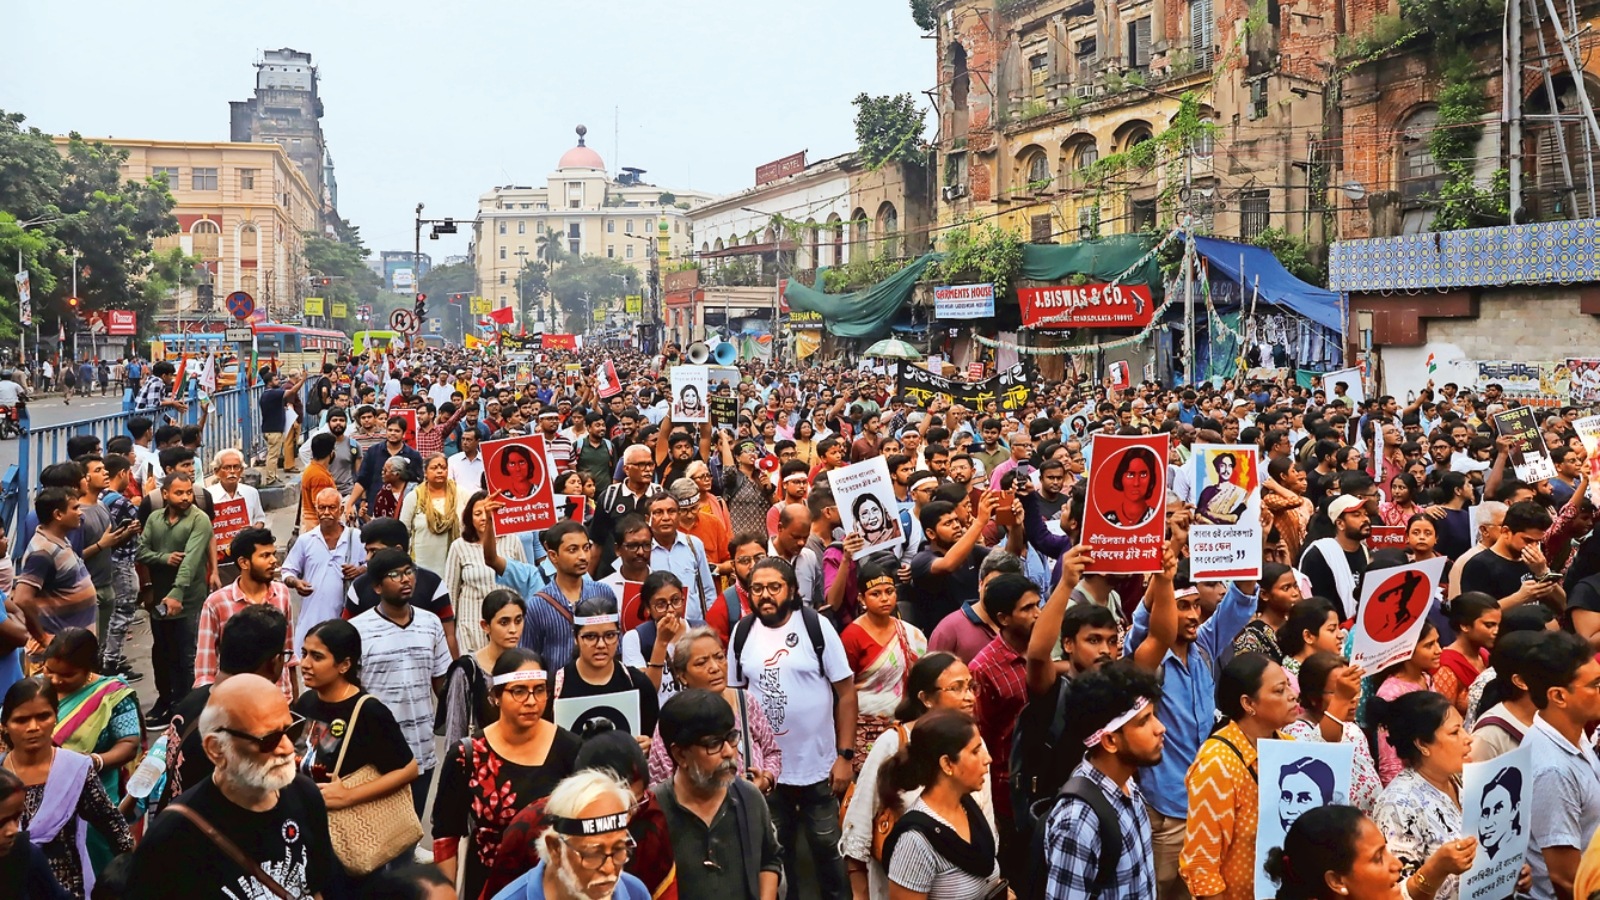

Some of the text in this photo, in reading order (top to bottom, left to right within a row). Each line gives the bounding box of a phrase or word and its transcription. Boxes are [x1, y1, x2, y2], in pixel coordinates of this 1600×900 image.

[782, 159, 800, 172] HOTEL
[936, 286, 992, 299] GARMENTS HOUSE
[1035, 288, 1087, 308] J.BISWAS
[1103, 286, 1128, 305] CO.
[1127, 534, 1138, 545] এই
[1193, 530, 1211, 538] কারার
[1141, 547, 1158, 560] নাই
[582, 819, 595, 833] WE
[595, 816, 618, 832] WANT
